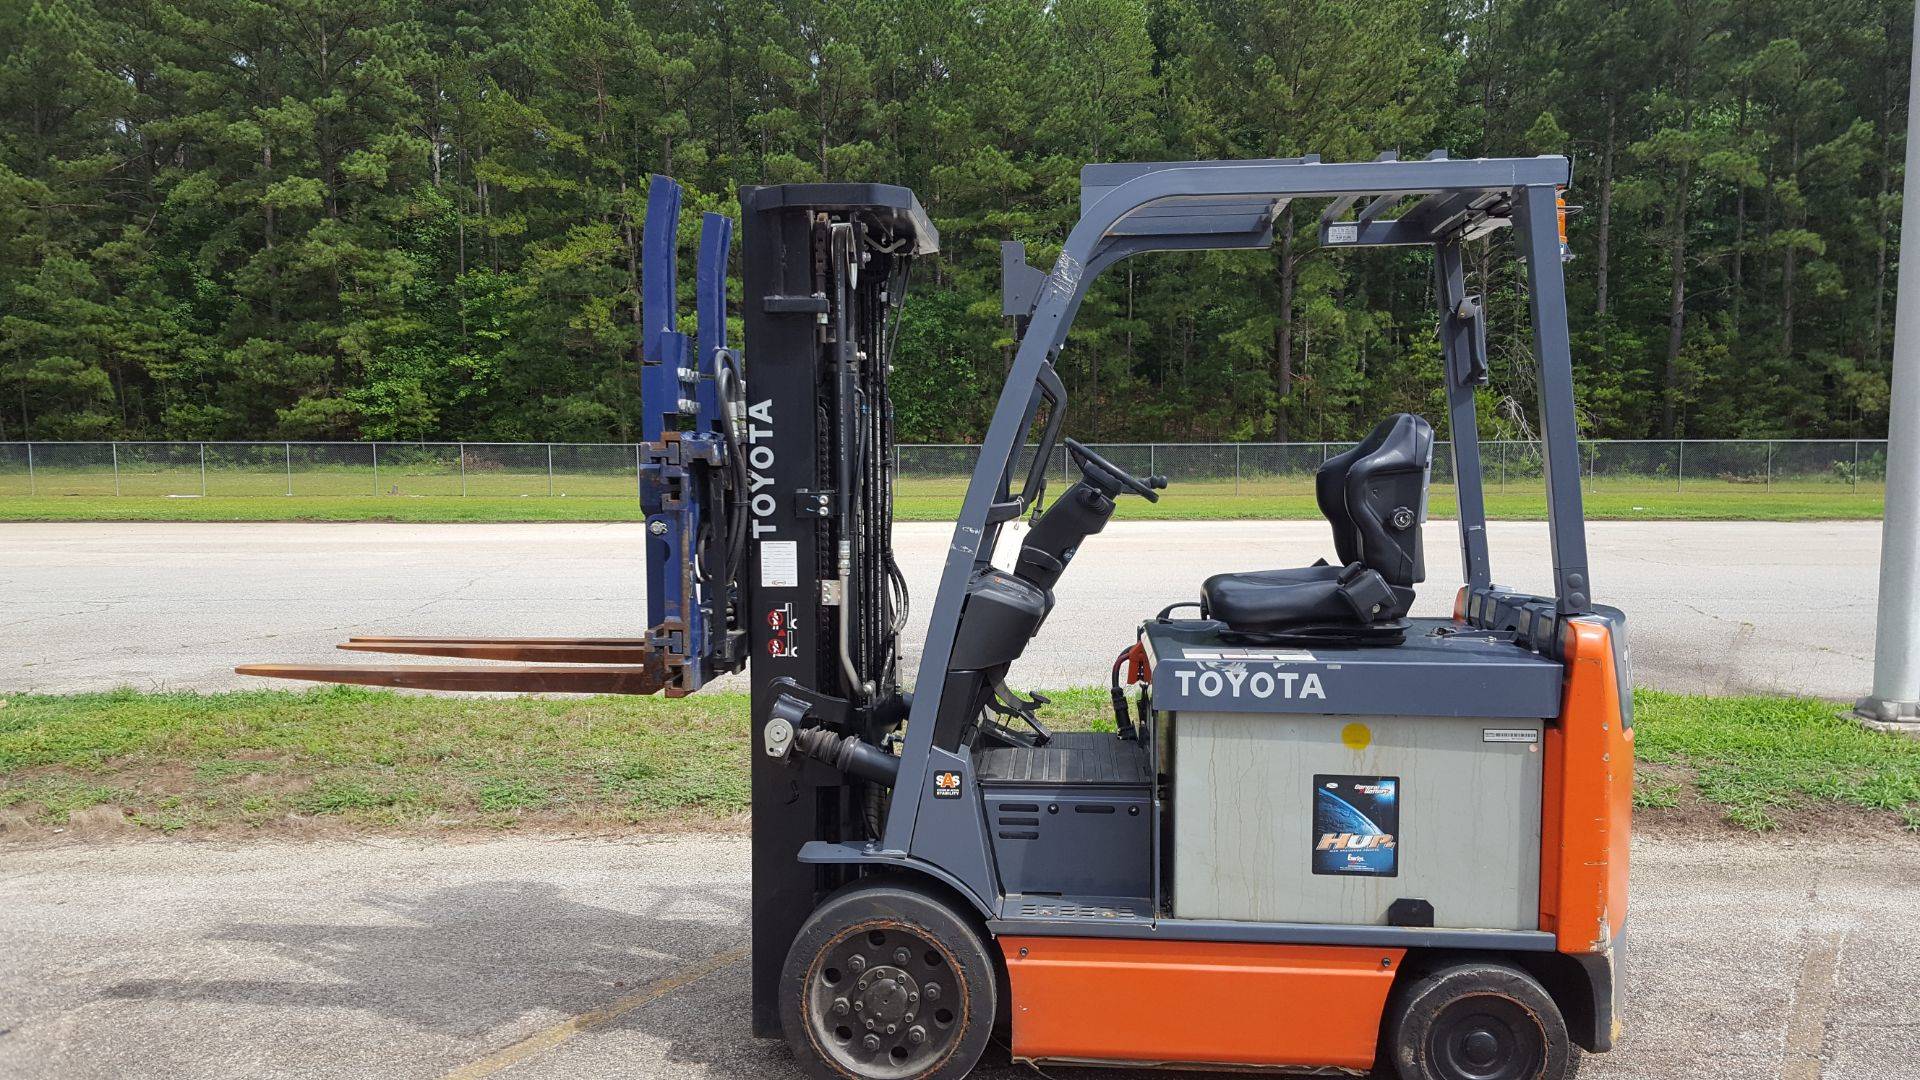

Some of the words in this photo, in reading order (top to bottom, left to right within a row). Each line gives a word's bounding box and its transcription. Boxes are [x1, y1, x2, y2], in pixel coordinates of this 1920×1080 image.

[748, 399, 777, 539] TOYOTA
[1175, 670, 1327, 699] TOYOTA
[936, 773, 960, 787] SAS
